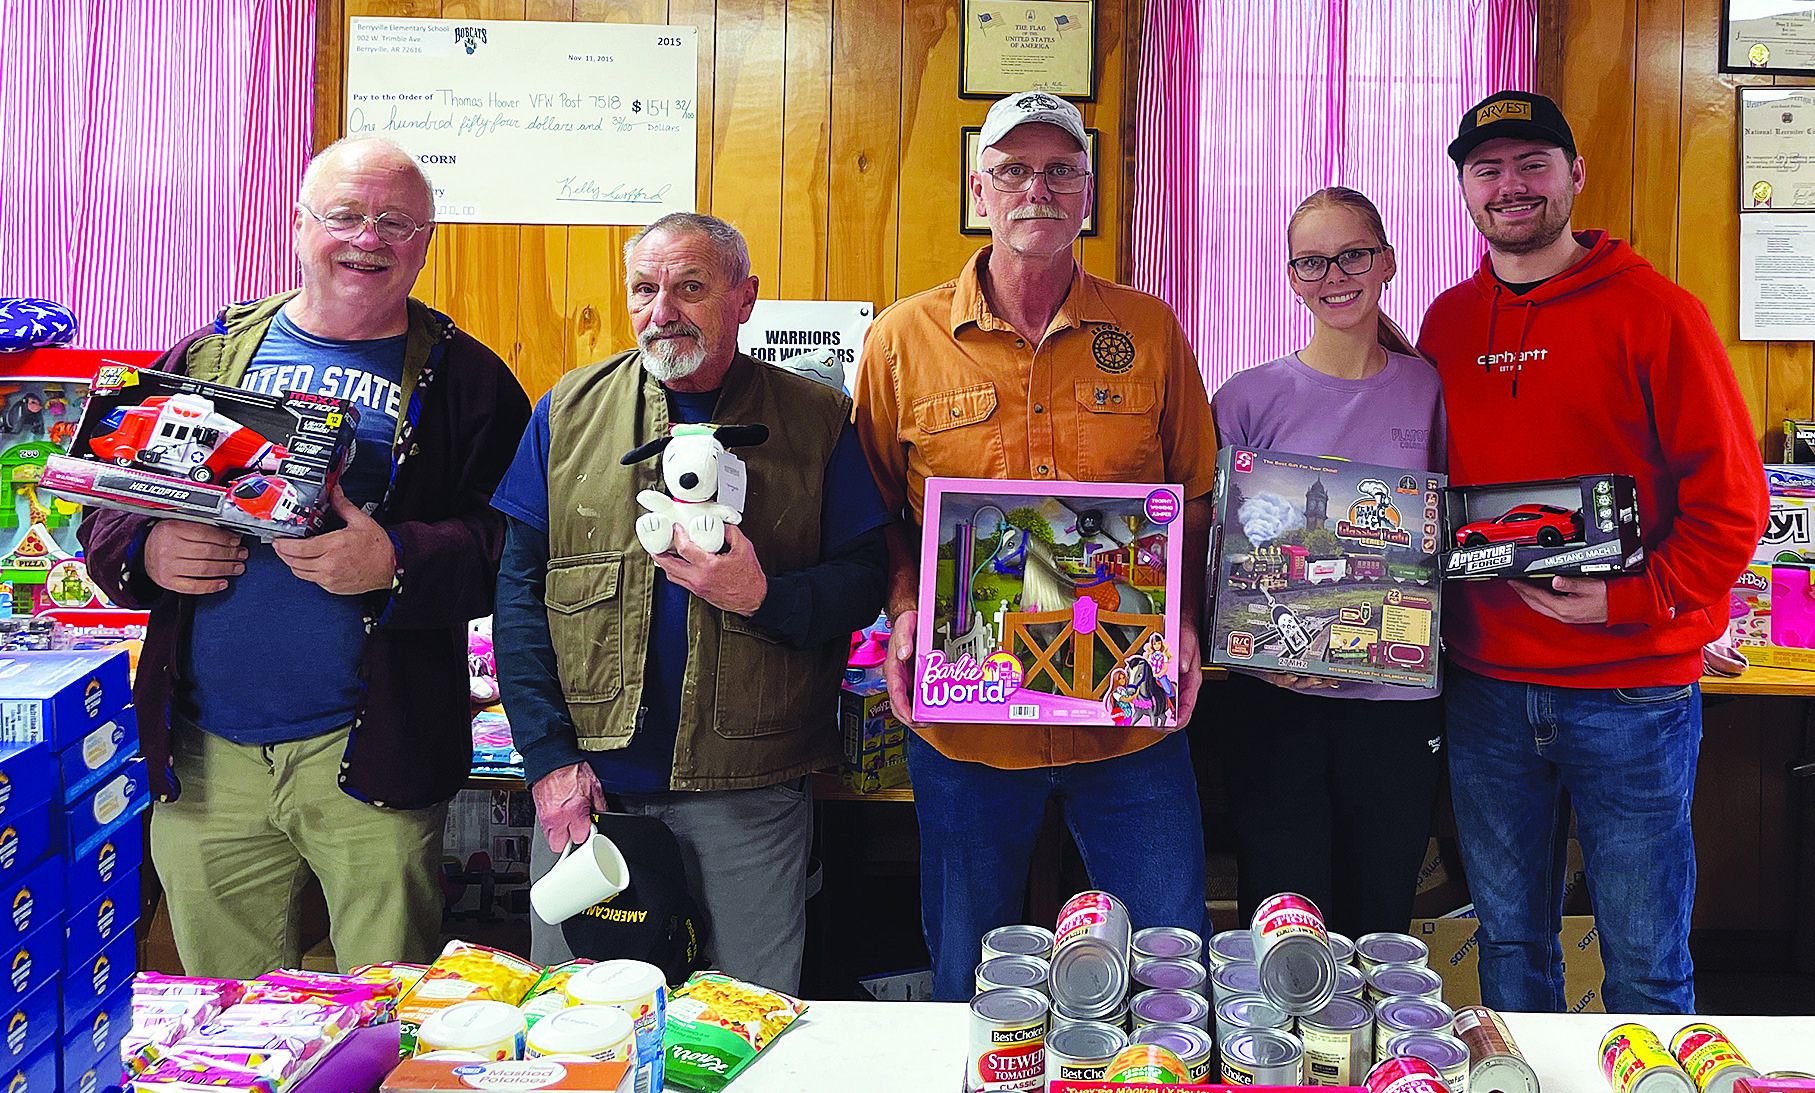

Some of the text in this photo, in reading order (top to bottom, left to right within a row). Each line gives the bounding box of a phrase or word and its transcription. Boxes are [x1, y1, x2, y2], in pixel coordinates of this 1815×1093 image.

[357, 24, 388, 32] Berryville
[389, 25, 426, 33] Elementary
[454, 27, 487, 44] BOBCATS
[657, 37, 682, 46] 2015
[353, 94, 368, 102] Pay
[436, 89, 621, 110] Thomas Hoover VFW Post 7518
[631, 99, 642, 114] $
[646, 99, 669, 117] 154
[1479, 102, 1530, 121] ARVEST
[350, 107, 376, 132] One
[382, 104, 454, 131] hundred
[525, 115, 573, 131] dollars
[577, 117, 604, 131] and
[765, 330, 841, 346] WARRIORS
[750, 347, 776, 362] FOR
[1477, 348, 1548, 365] carhartt
[100, 366, 123, 377] TRY
[286, 400, 340, 413] ACTION
[290, 392, 341, 406] MAXX
[20, 450, 39, 458] ZOO
[129, 481, 190, 500] HELICOPTER
[1449, 544, 1512, 568] ADVENTURE
[1472, 556, 1508, 569] FORCE
[1544, 552, 1585, 566] MUSTANG
[1586, 547, 1610, 558] MACH
[18, 560, 45, 568] PIZZA
[1232, 636, 1250, 646] R/C
[922, 652, 983, 684] Barbie
[920, 680, 1005, 706] World
[586, 905, 648, 922] AMERICAN
[1450, 935, 1477, 966] sam's
[993, 1027, 1043, 1042] Best Choice
[672, 1044, 730, 1074] Knorr
[988, 1048, 1044, 1070] STEWED
[479, 1076, 548, 1084] Potatoes
[488, 1069, 553, 1077] Mashed
[994, 1065, 1041, 1080] TOMATOES
[1061, 1067, 1081, 1080] Best
[1224, 1064, 1252, 1085] Choice
[1000, 1079, 1037, 1091] CLASSIC
